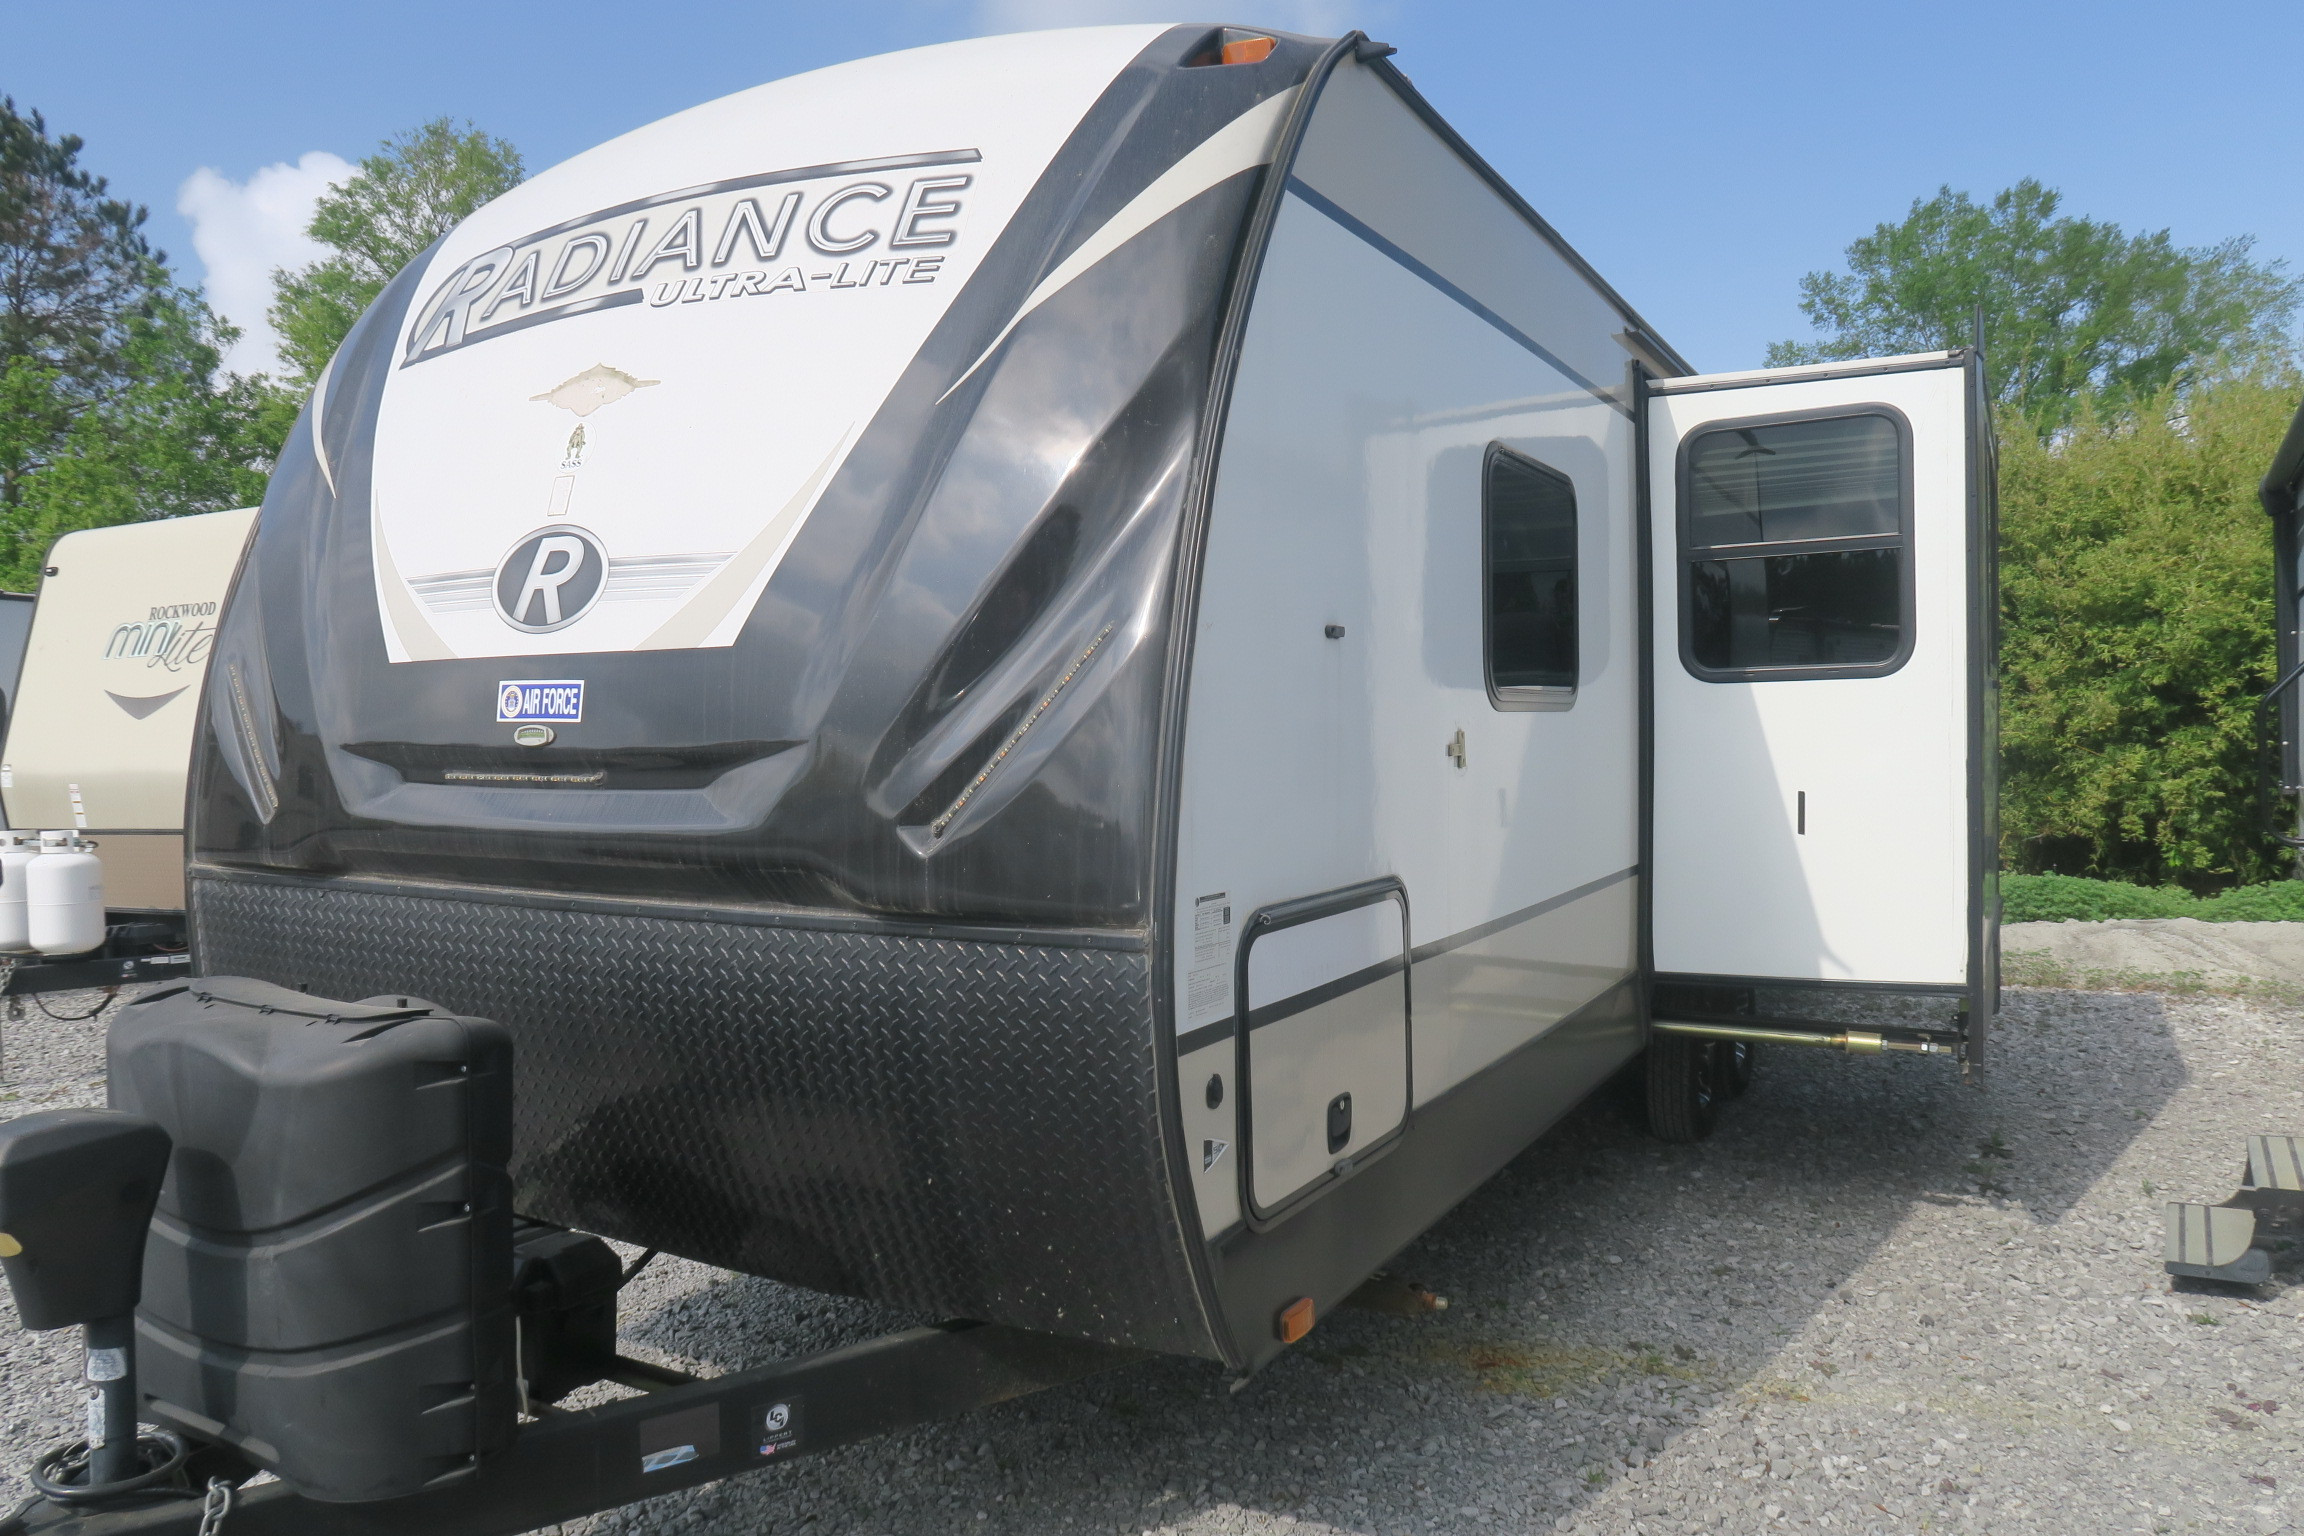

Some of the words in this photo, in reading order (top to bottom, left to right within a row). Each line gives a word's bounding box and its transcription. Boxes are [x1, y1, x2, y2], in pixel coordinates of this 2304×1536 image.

[402, 174, 970, 367] RADIANCE
[649, 256, 945, 308] ULTRA-LITE
[560, 458, 583, 470] SASS
[512, 535, 585, 625] R
[148, 601, 217, 620] ROCKWOOD
[522, 688, 541, 715] AIR
[541, 687, 579, 715] FORCE
